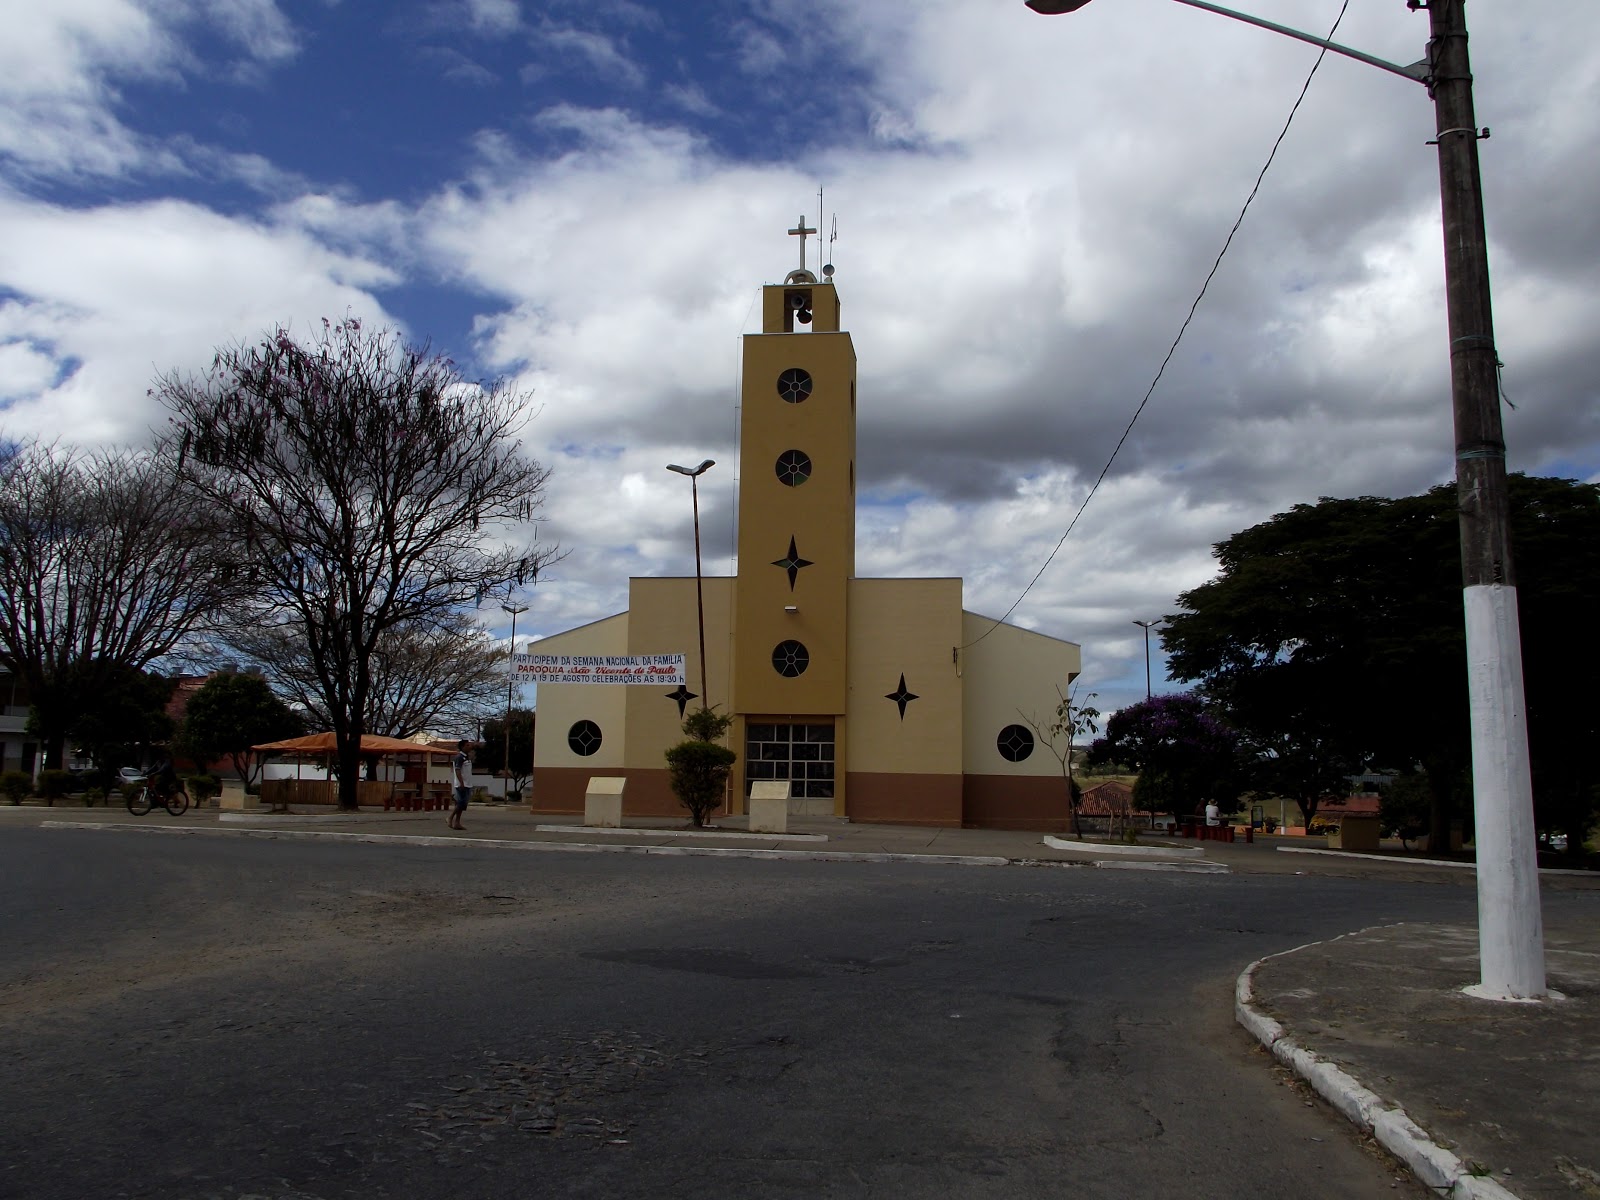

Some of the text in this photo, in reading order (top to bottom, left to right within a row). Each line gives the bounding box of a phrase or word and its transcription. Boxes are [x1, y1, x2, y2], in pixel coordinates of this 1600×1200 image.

[512, 654, 558, 665] PARTICIPEM
[561, 656, 570, 665] DA
[572, 656, 604, 666] SEMANA
[606, 656, 639, 666] NACIONAL
[642, 656, 652, 665] DA
[647, 666, 676, 674] Paulo
[562, 674, 590, 682] AGOSTO
[592, 674, 642, 684] CELEBRAÇÕES
[658, 674, 676, 683] 19:30
